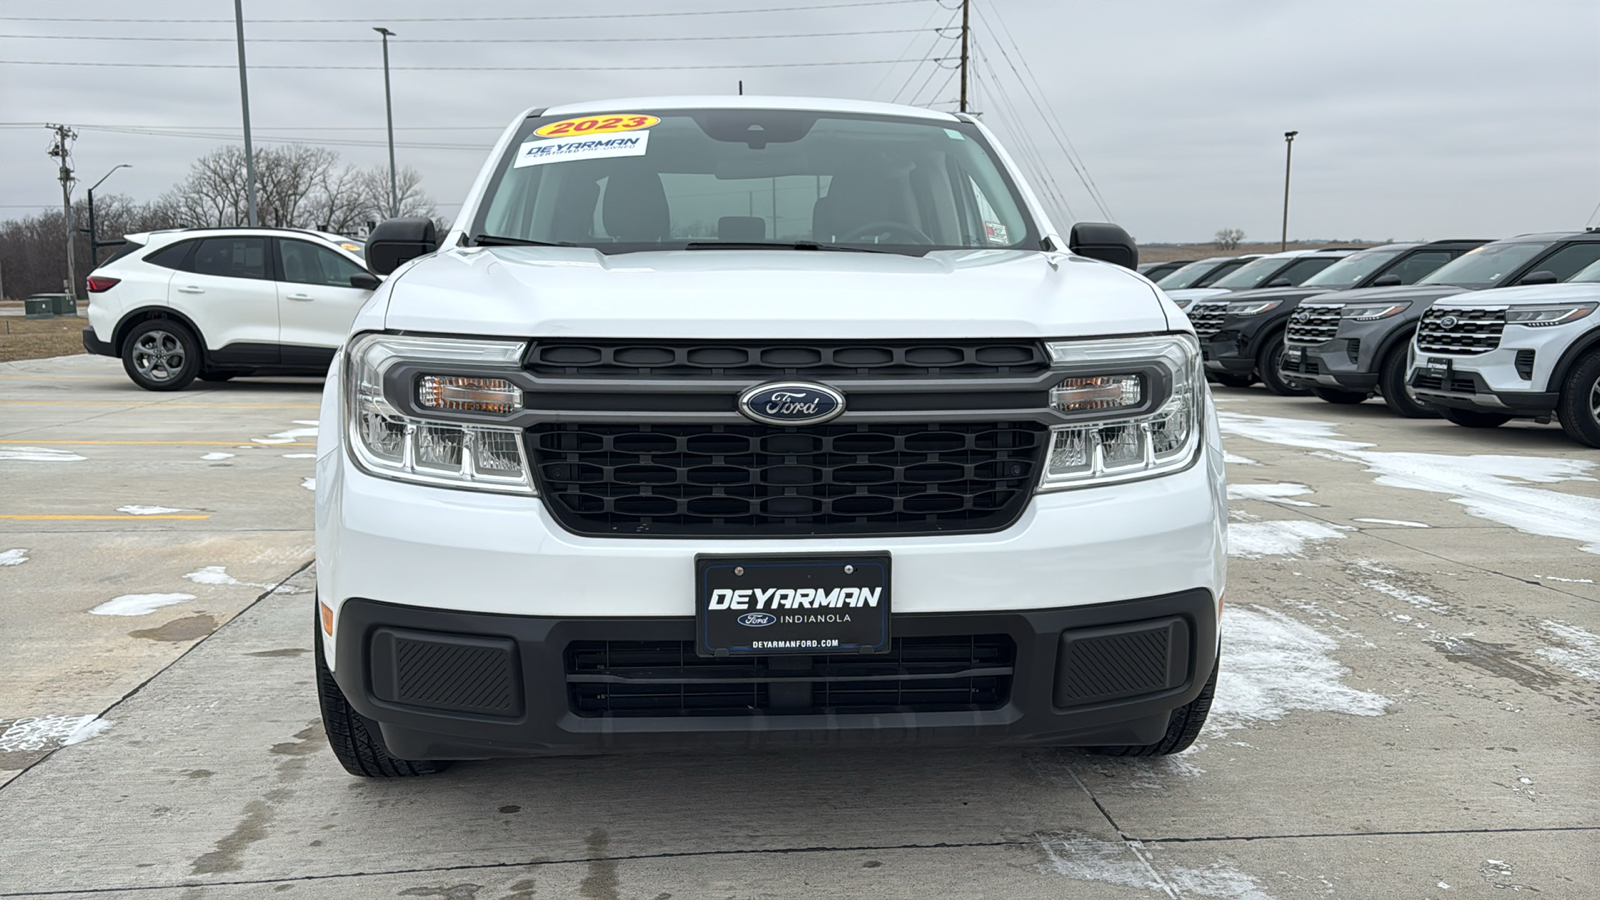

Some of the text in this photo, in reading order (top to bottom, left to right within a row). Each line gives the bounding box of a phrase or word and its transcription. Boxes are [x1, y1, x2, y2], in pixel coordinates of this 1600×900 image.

[546, 116, 648, 136] 2023
[526, 137, 640, 156] DEYARMAN
[532, 144, 636, 158] CERTIFIED PRE-OWNED
[766, 391, 819, 414] Ford
[708, 587, 882, 610] DEYARMAN
[780, 614, 851, 624] INDIANOLA
[752, 639, 839, 649] DEYARMANFORD.COM
